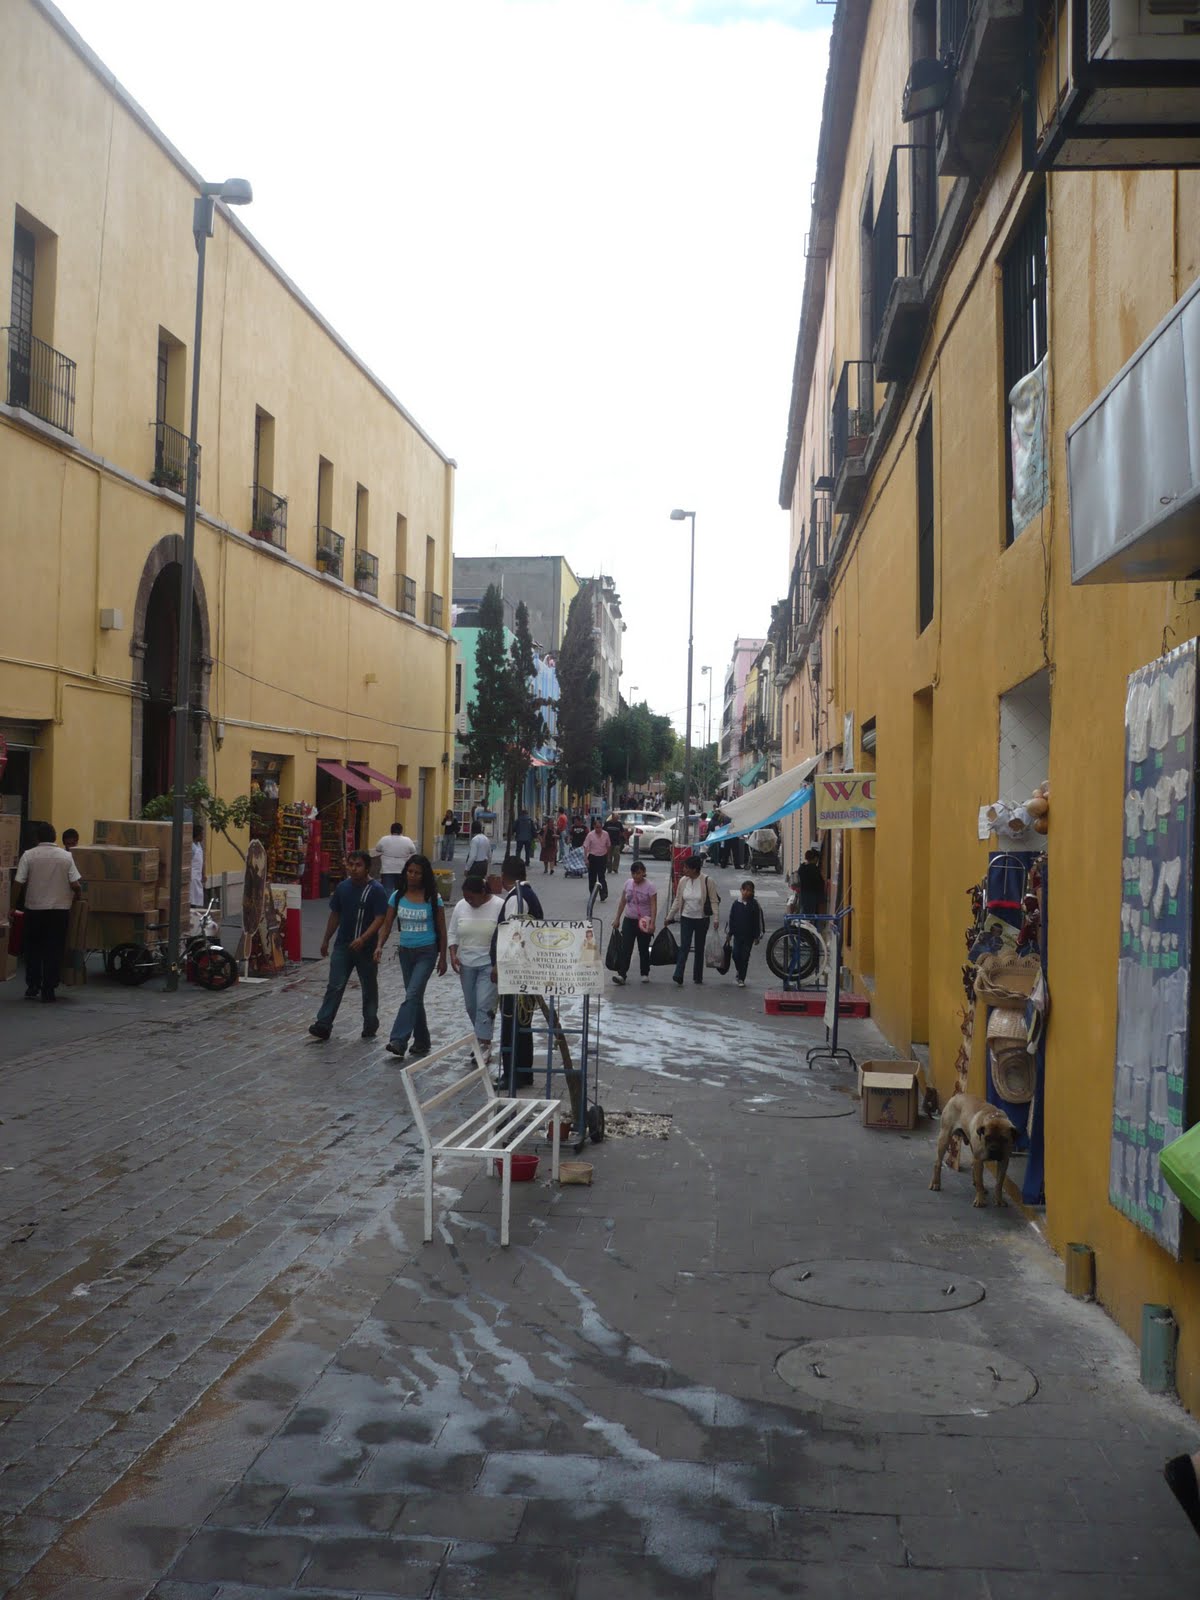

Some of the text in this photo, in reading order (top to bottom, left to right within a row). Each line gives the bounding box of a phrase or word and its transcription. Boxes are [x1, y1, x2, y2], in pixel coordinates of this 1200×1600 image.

[820, 810, 869, 819] SANITARIOS
[521, 920, 584, 928] TALAVERA
[544, 985, 575, 995] PISO
